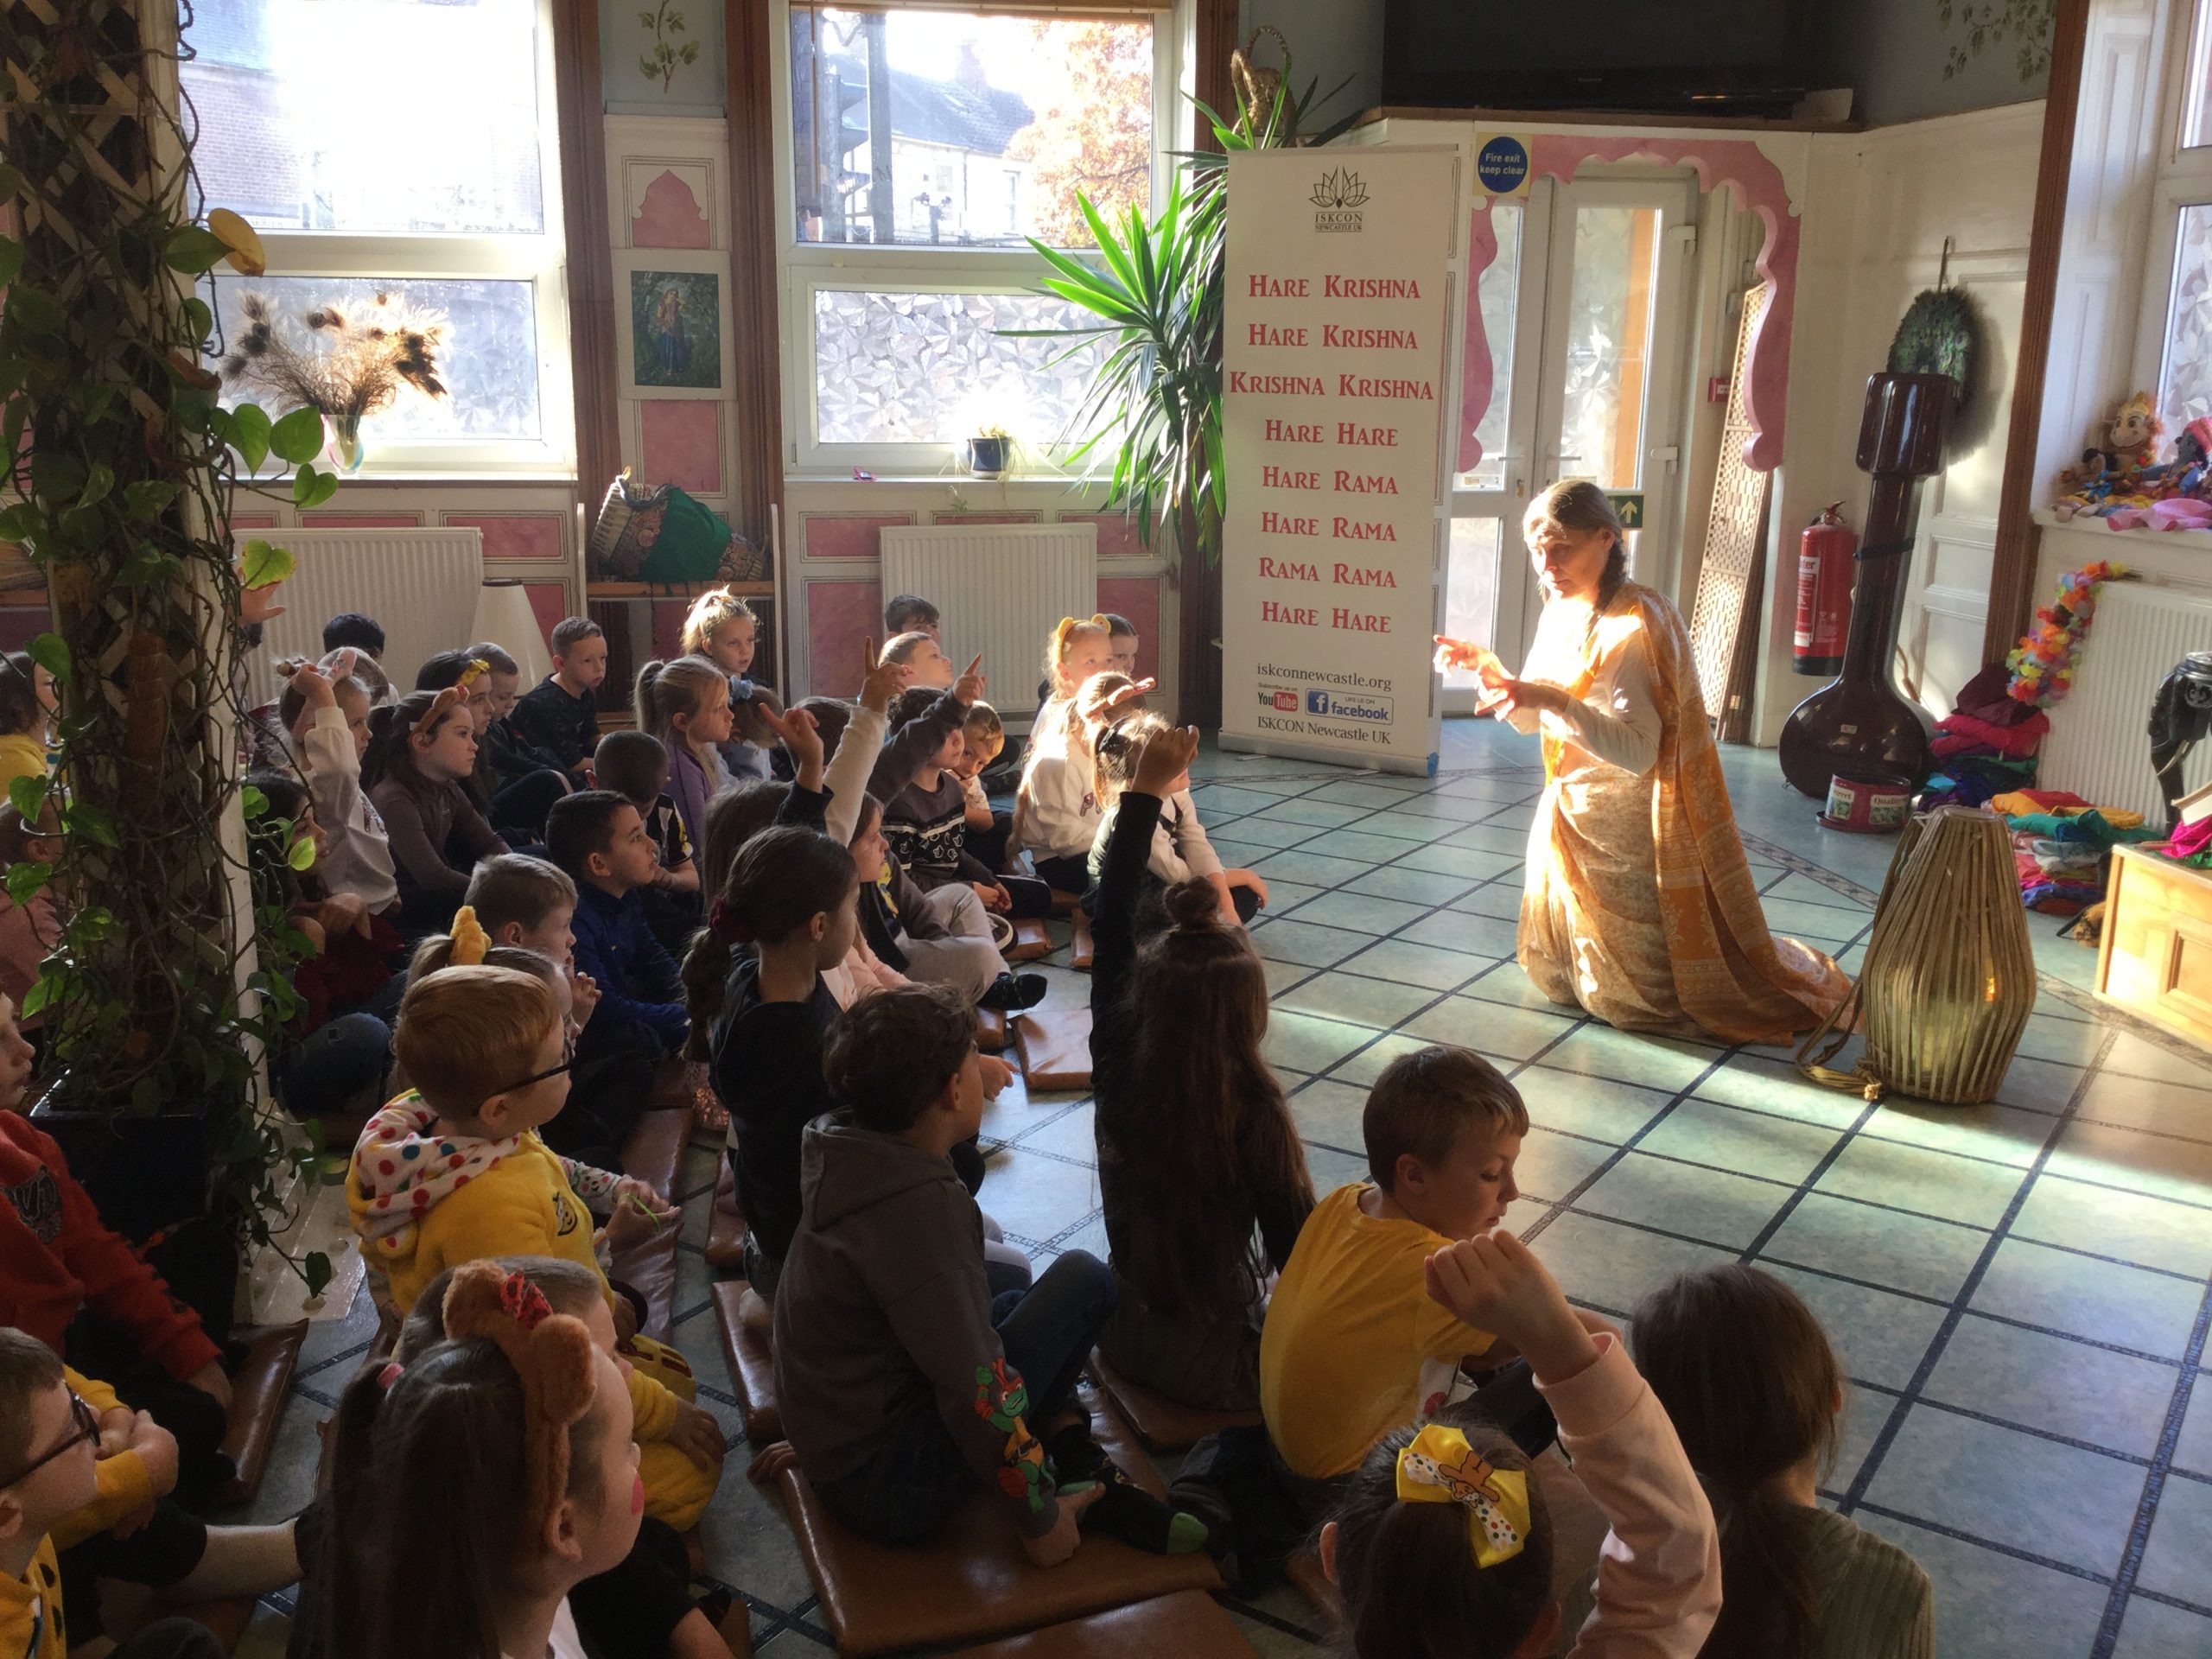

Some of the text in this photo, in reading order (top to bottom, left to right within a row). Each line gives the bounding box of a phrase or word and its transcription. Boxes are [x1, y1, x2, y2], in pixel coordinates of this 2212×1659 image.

[1479, 165, 1525, 176] keep clear
[1485, 152, 1521, 163] Fire exit
[1315, 213, 1363, 223] ISKCON
[1249, 274, 1421, 300] HARE KRISHNA
[1248, 323, 1419, 349] HARE KRISHNA
[1230, 372, 1434, 401] KRISHNA KRISHNA
[1264, 419, 1398, 447] HARE HARE
[1262, 466, 1399, 495] HARE RAMA
[1261, 512, 1397, 543] HARE RAMA
[1258, 556, 1397, 589] RAMA RAMA
[1261, 601, 1392, 633] HARE HARE
[1257, 663, 1392, 692] iskconnewcastle.org
[1331, 701, 1389, 721] facebook
[1257, 715, 1391, 745] ISKCON Newcastle UK
